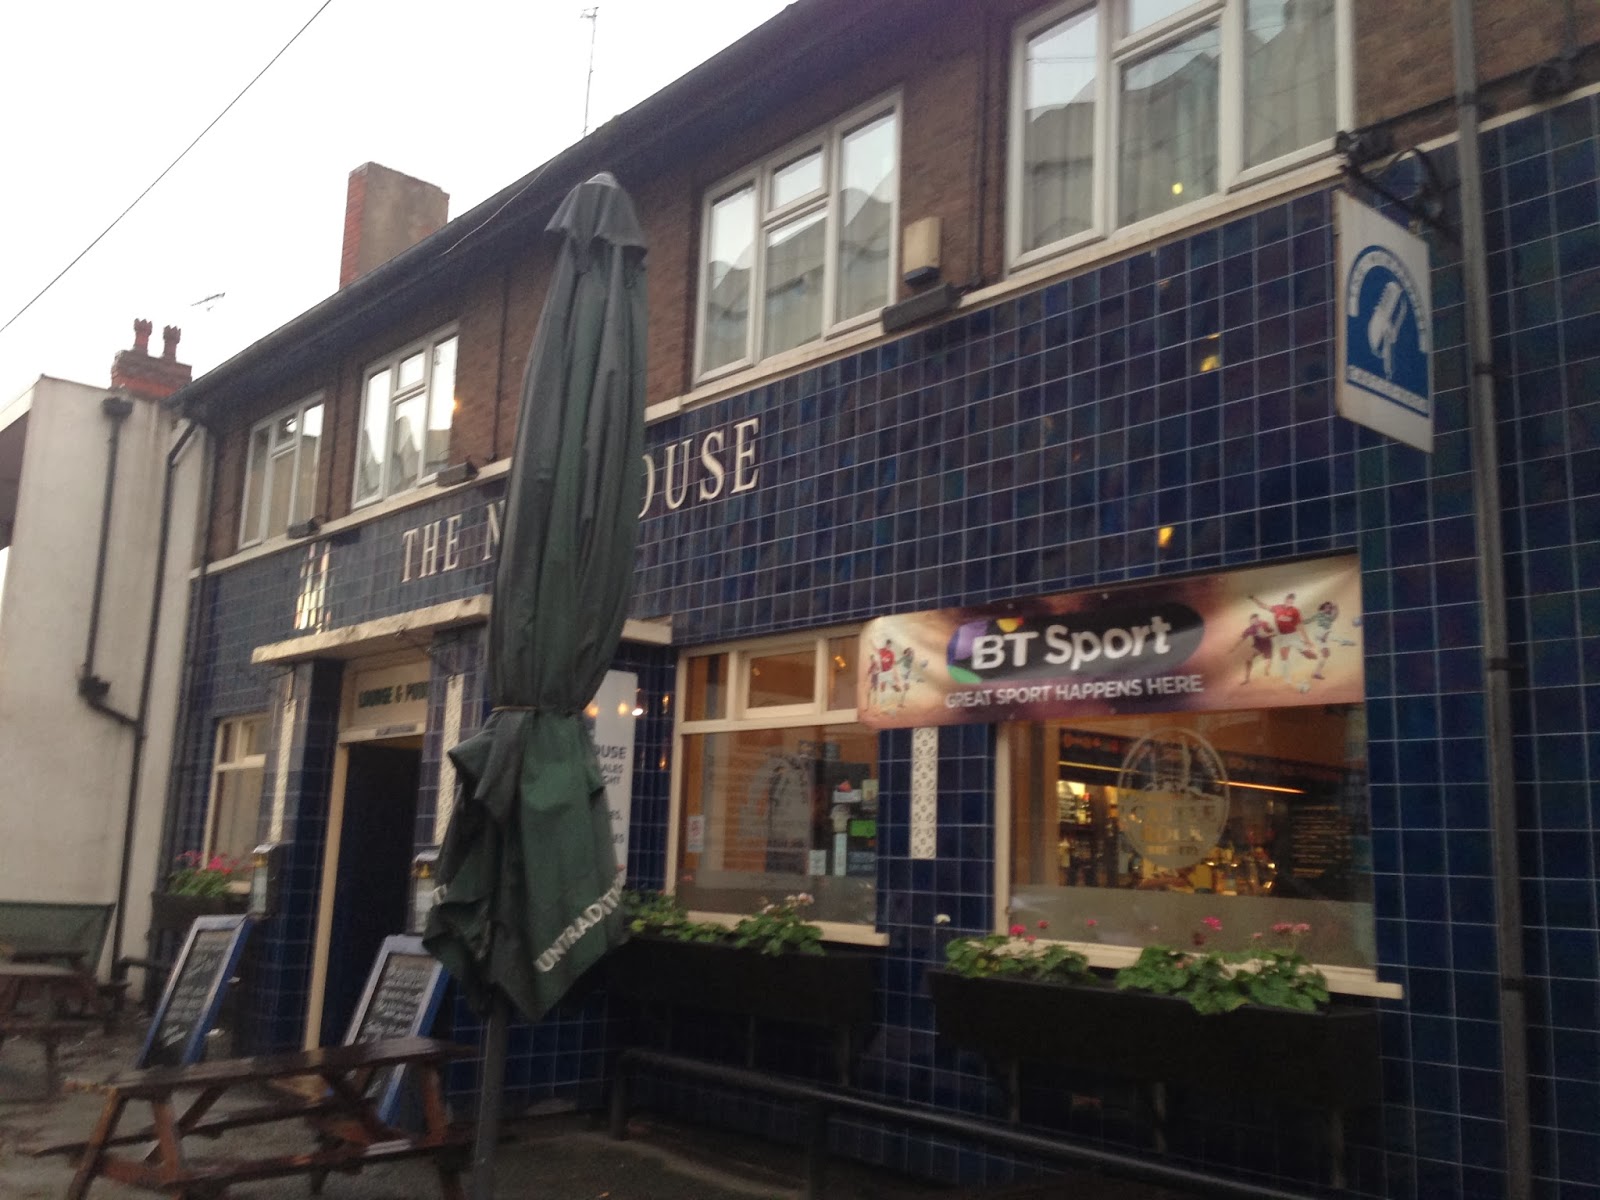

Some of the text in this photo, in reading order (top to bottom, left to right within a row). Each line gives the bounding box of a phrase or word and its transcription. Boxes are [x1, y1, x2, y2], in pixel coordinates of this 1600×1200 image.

[402, 514, 462, 583] THE
[972, 615, 1172, 671] BT Sport
[945, 674, 1205, 709] GREAT SPORT HAPPENS HERE
